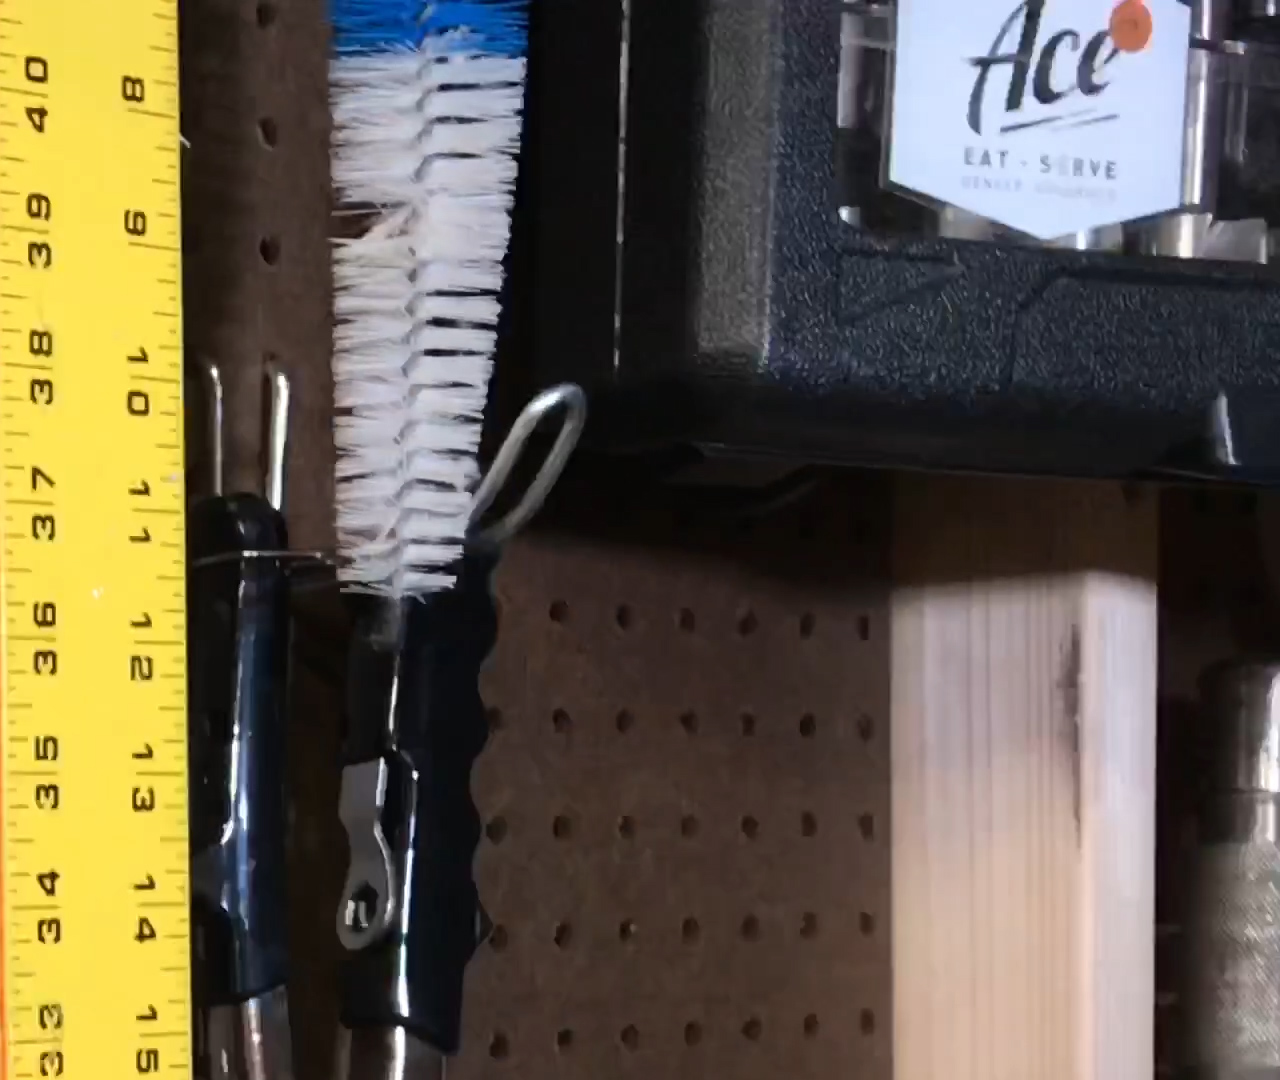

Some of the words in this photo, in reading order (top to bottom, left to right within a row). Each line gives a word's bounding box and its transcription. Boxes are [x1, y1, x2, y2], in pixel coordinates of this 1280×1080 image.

[24, 56, 48, 133] 40
[965, 0, 1120, 136] Ace
[963, 147, 1009, 169] EAT
[26, 193, 52, 268] 39
[29, 329, 53, 405] 38
[126, 346, 150, 416] 10
[31, 466, 55, 541] 37
[128, 480, 152, 544] 11
[33, 602, 57, 676] 36
[129, 611, 153, 681] 12
[34, 735, 59, 810] 35
[131, 742, 155, 812] 13
[36, 868, 61, 944] 34
[133, 873, 157, 944] 14
[38, 1003, 64, 1077] 33
[136, 1003, 159, 1074] 15
